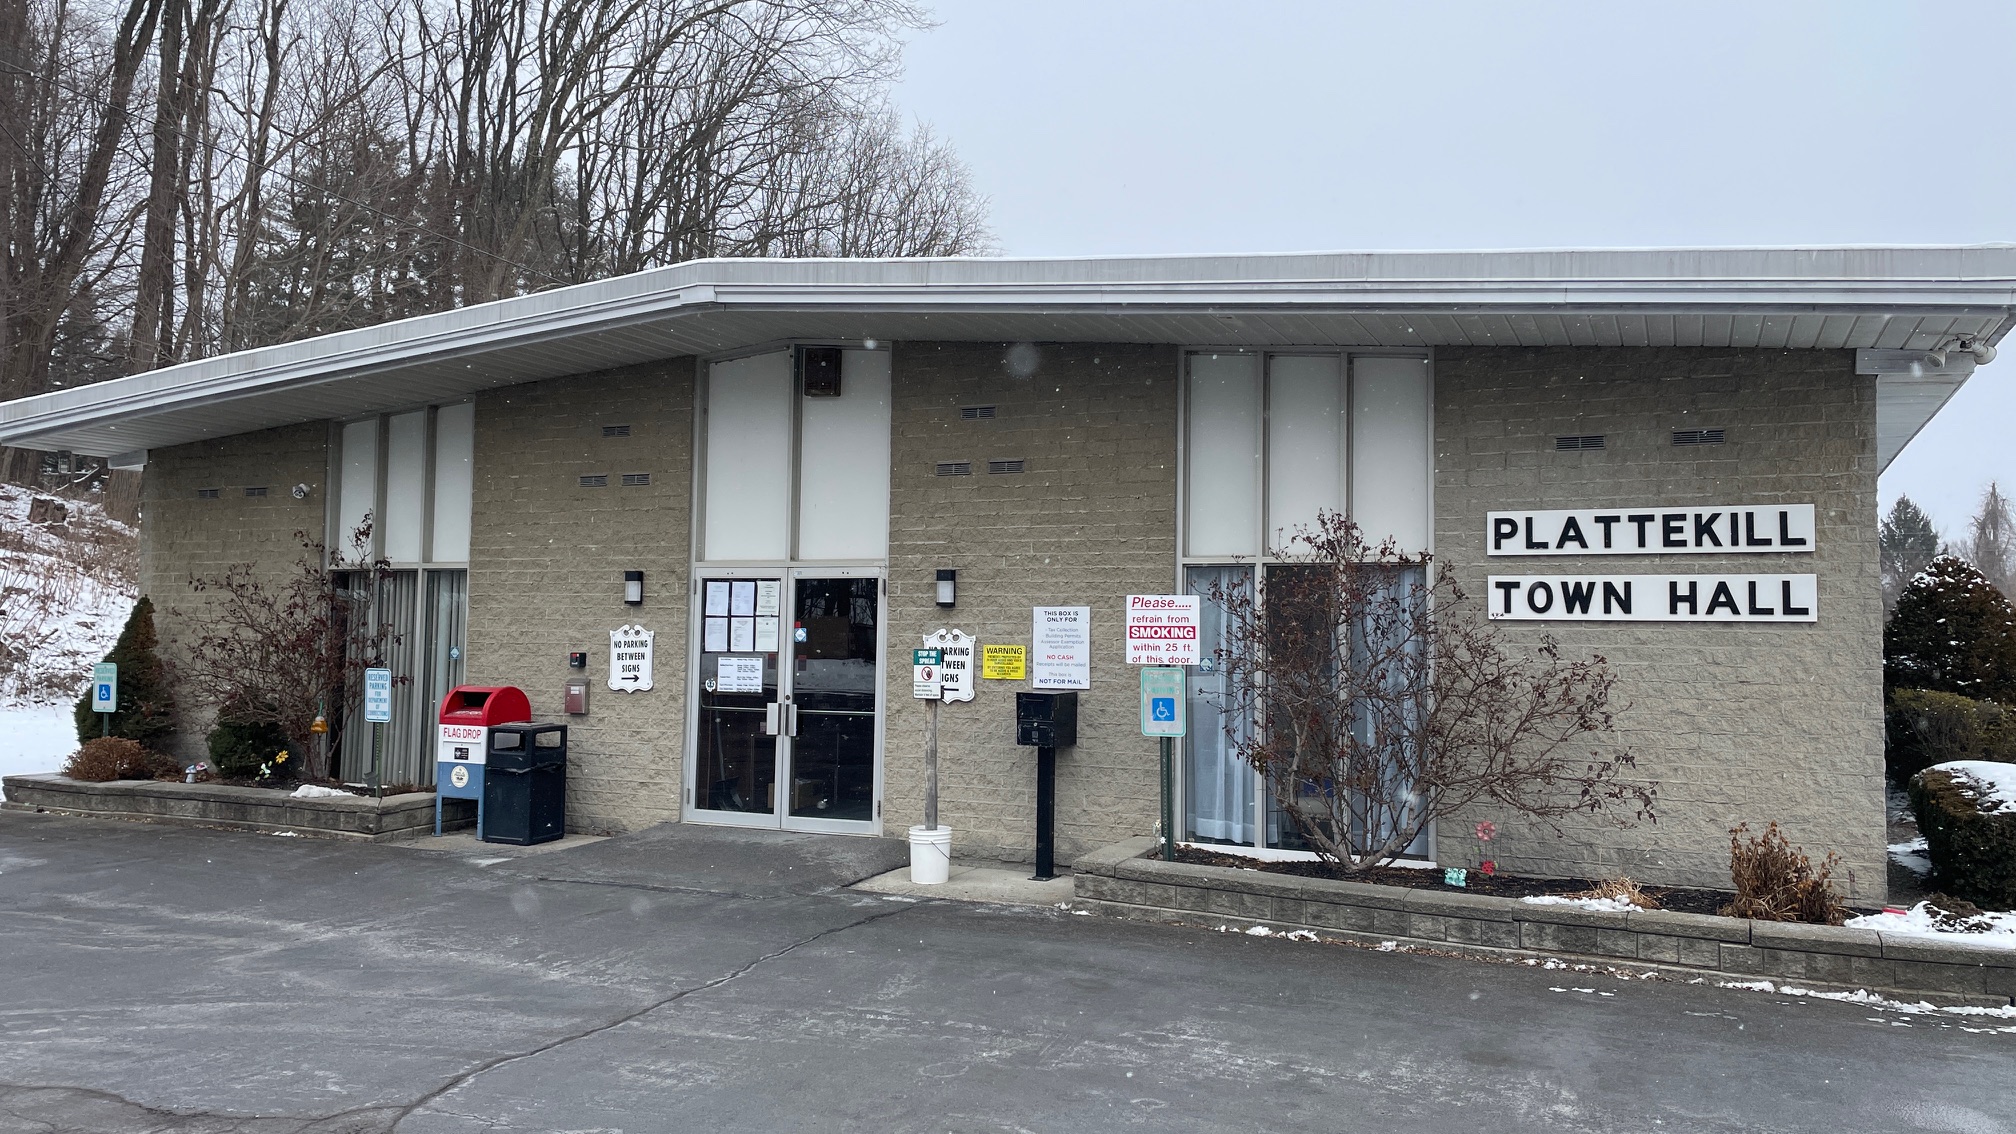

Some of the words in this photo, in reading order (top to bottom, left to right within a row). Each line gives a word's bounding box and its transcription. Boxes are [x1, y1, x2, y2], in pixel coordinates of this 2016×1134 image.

[1494, 511, 1807, 550] PLATTEKILL
[1495, 581, 1632, 615] TOWN
[1669, 580, 1809, 616] HALL
[1132, 615, 1162, 623] refrain
[1168, 615, 1190, 623] from
[1130, 626, 1194, 638] SMOKING
[624, 640, 648, 648] PARKING
[1133, 643, 1160, 651] within
[1165, 643, 1178, 652] 25
[617, 652, 645, 660] BETWEEN
[941, 647, 970, 656] ARKING
[1132, 655, 1141, 663] of
[1147, 655, 1164, 663] this
[941, 660, 966, 669] TWEEN
[942, 674, 959, 682] IGNS
[369, 682, 387, 690] PARKING
[444, 727, 461, 738] FLAG
[463, 729, 481, 739] DROP
